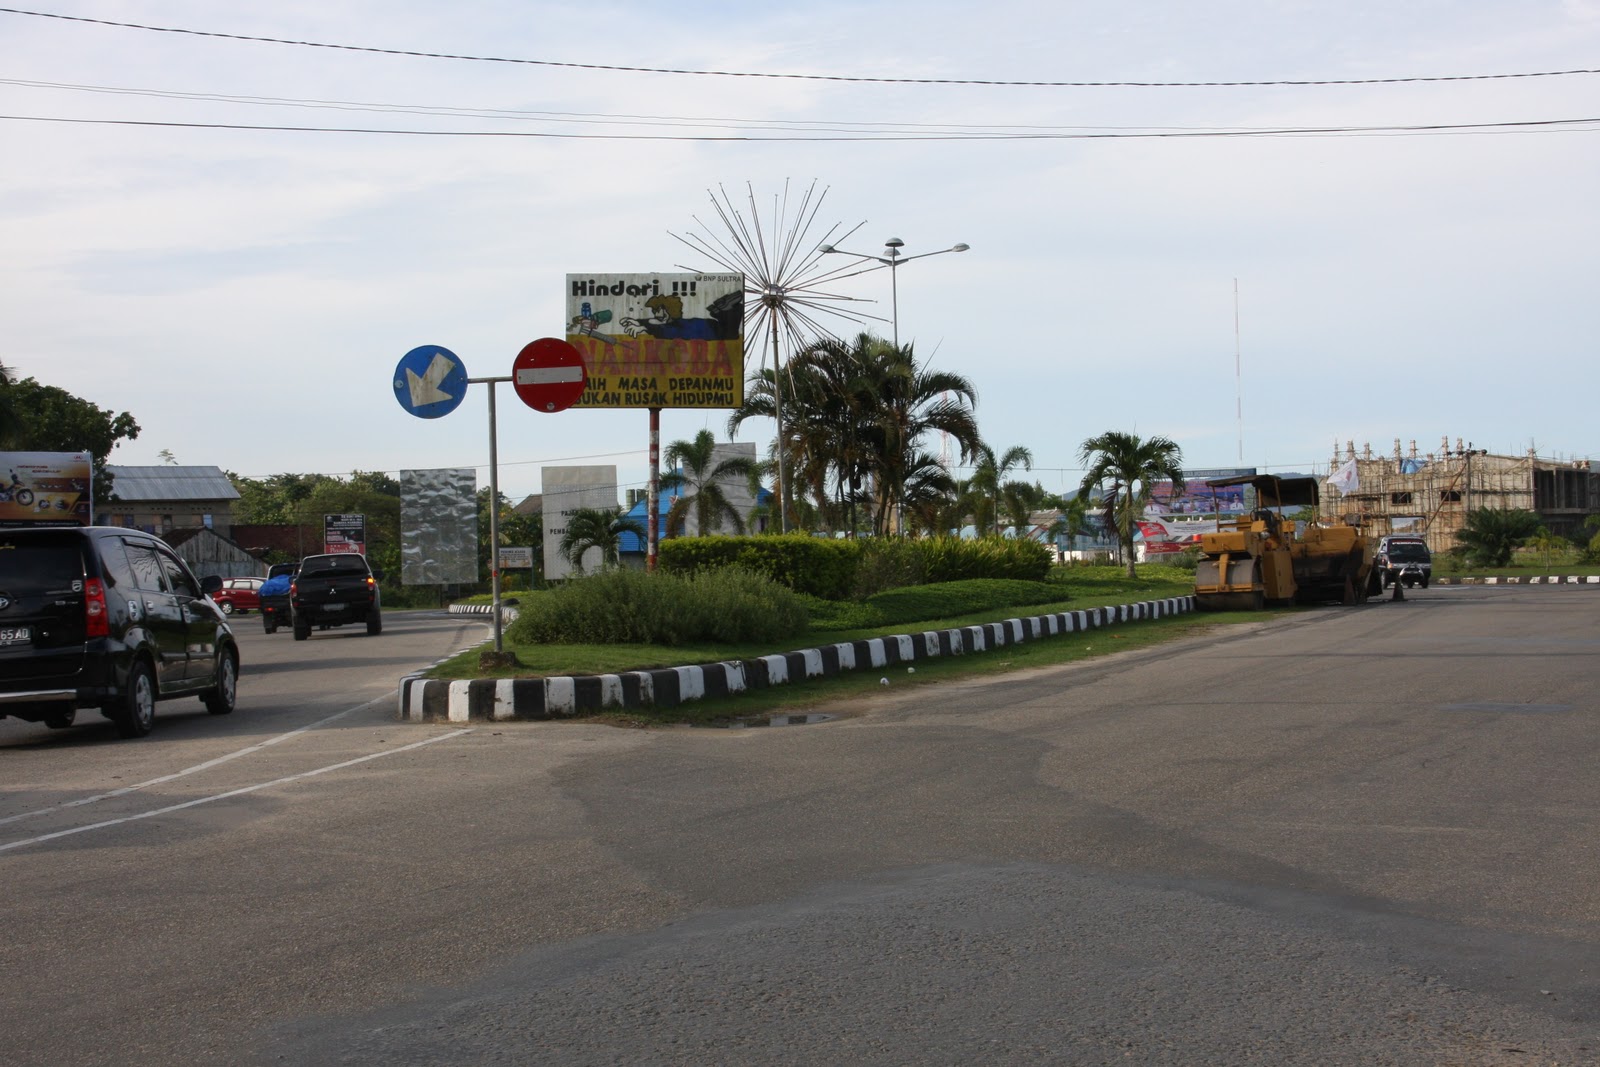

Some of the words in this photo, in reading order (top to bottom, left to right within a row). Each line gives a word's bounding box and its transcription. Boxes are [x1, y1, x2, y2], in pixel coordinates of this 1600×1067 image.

[572, 279, 659, 297] Hindari
[672, 281, 697, 297] !!!
[574, 338, 734, 376] NARKOBA
[586, 376, 606, 391] AIH
[618, 377, 658, 391] MASA
[669, 376, 734, 391] DEPANMU
[625, 391, 668, 405] RUSAK
[673, 391, 734, 406] HIDUPMU
